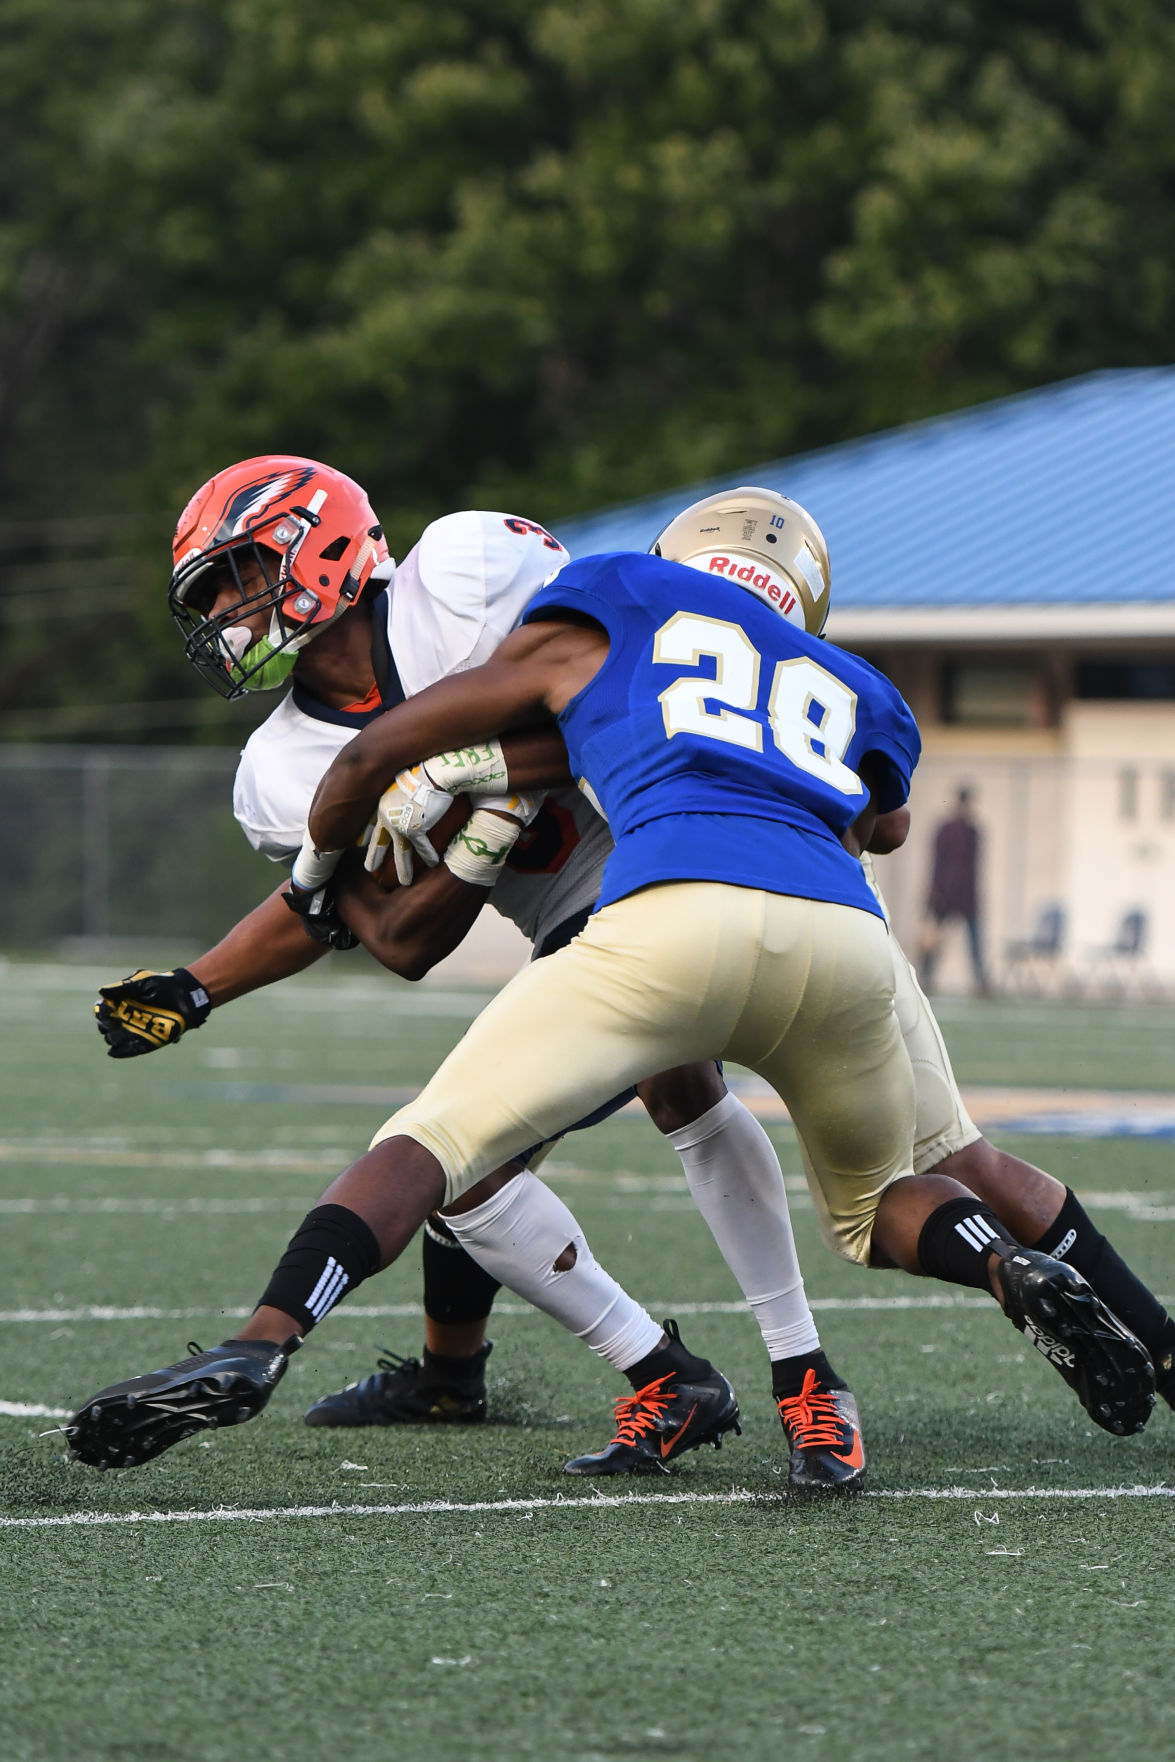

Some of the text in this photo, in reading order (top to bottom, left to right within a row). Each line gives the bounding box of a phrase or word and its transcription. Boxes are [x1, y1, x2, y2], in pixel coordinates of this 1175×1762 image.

[503, 518, 563, 552] 3
[769, 515, 785, 530] 10
[708, 556, 797, 616] Riddell
[652, 610, 864, 796] 28
